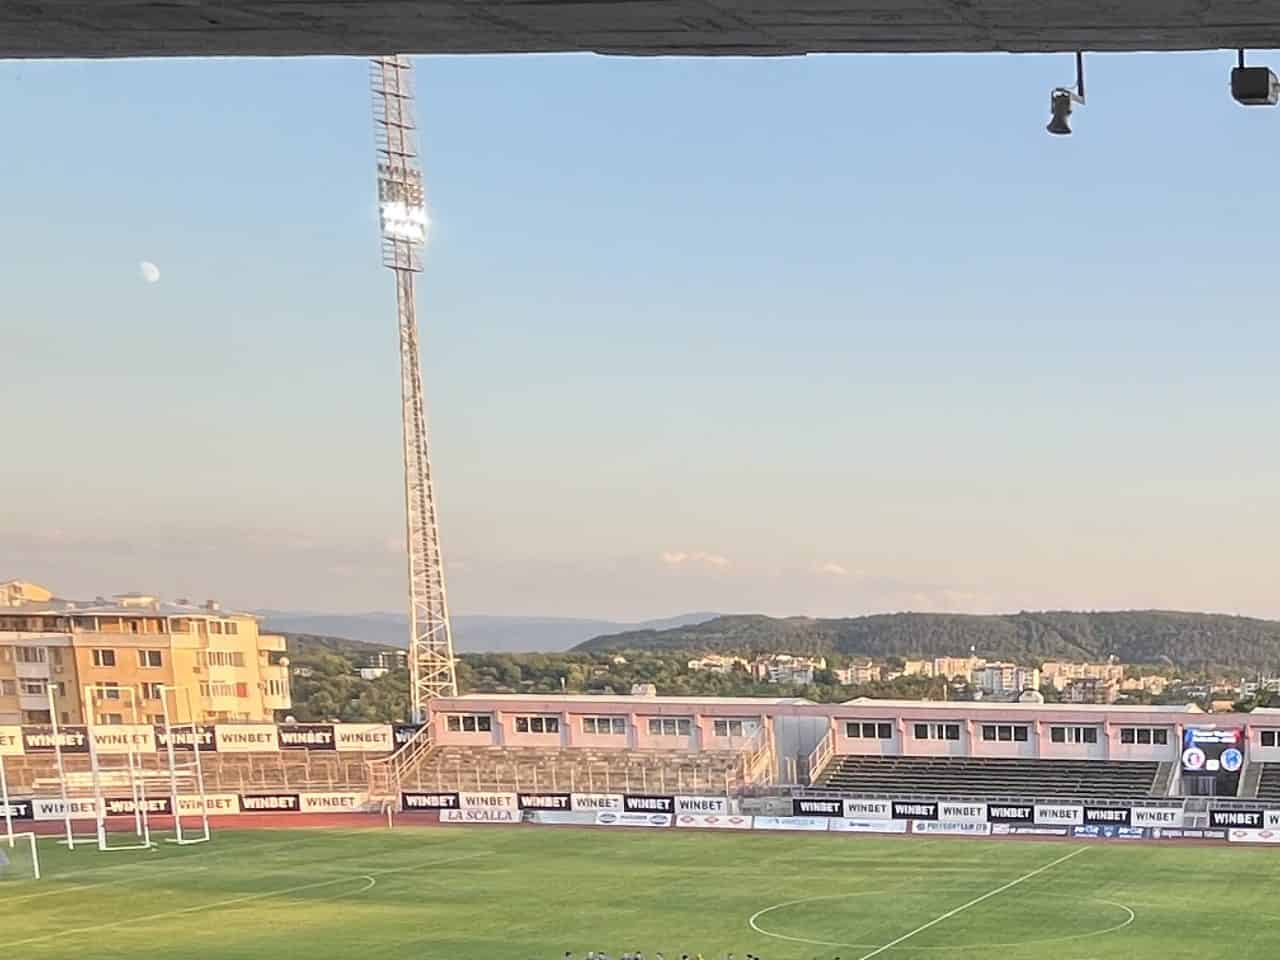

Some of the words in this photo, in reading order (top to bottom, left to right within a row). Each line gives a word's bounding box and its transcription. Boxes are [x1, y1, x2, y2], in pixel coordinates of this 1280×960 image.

[222, 733, 271, 743] WINBET
[281, 731, 332, 744] WINBET
[341, 733, 387, 743] WINBET
[242, 797, 297, 809] WINBET
[305, 797, 356, 807] WINBET
[405, 795, 455, 807] WINBET
[465, 796, 512, 807] WINBET
[521, 796, 568, 808] WINBET
[576, 797, 618, 808] WINBET
[627, 798, 672, 810] WINBET
[680, 799, 722, 811] WINBET
[800, 801, 841, 813] WINBET
[848, 804, 887, 813] WINBET
[894, 804, 936, 816] WINBET
[943, 807, 982, 817] WINBET
[990, 807, 1032, 819] WINBET
[1039, 808, 1080, 819] WINBET
[1086, 810, 1129, 822] WINBET
[1135, 812, 1177, 822] WINBET
[1214, 812, 1260, 825] WINBET
